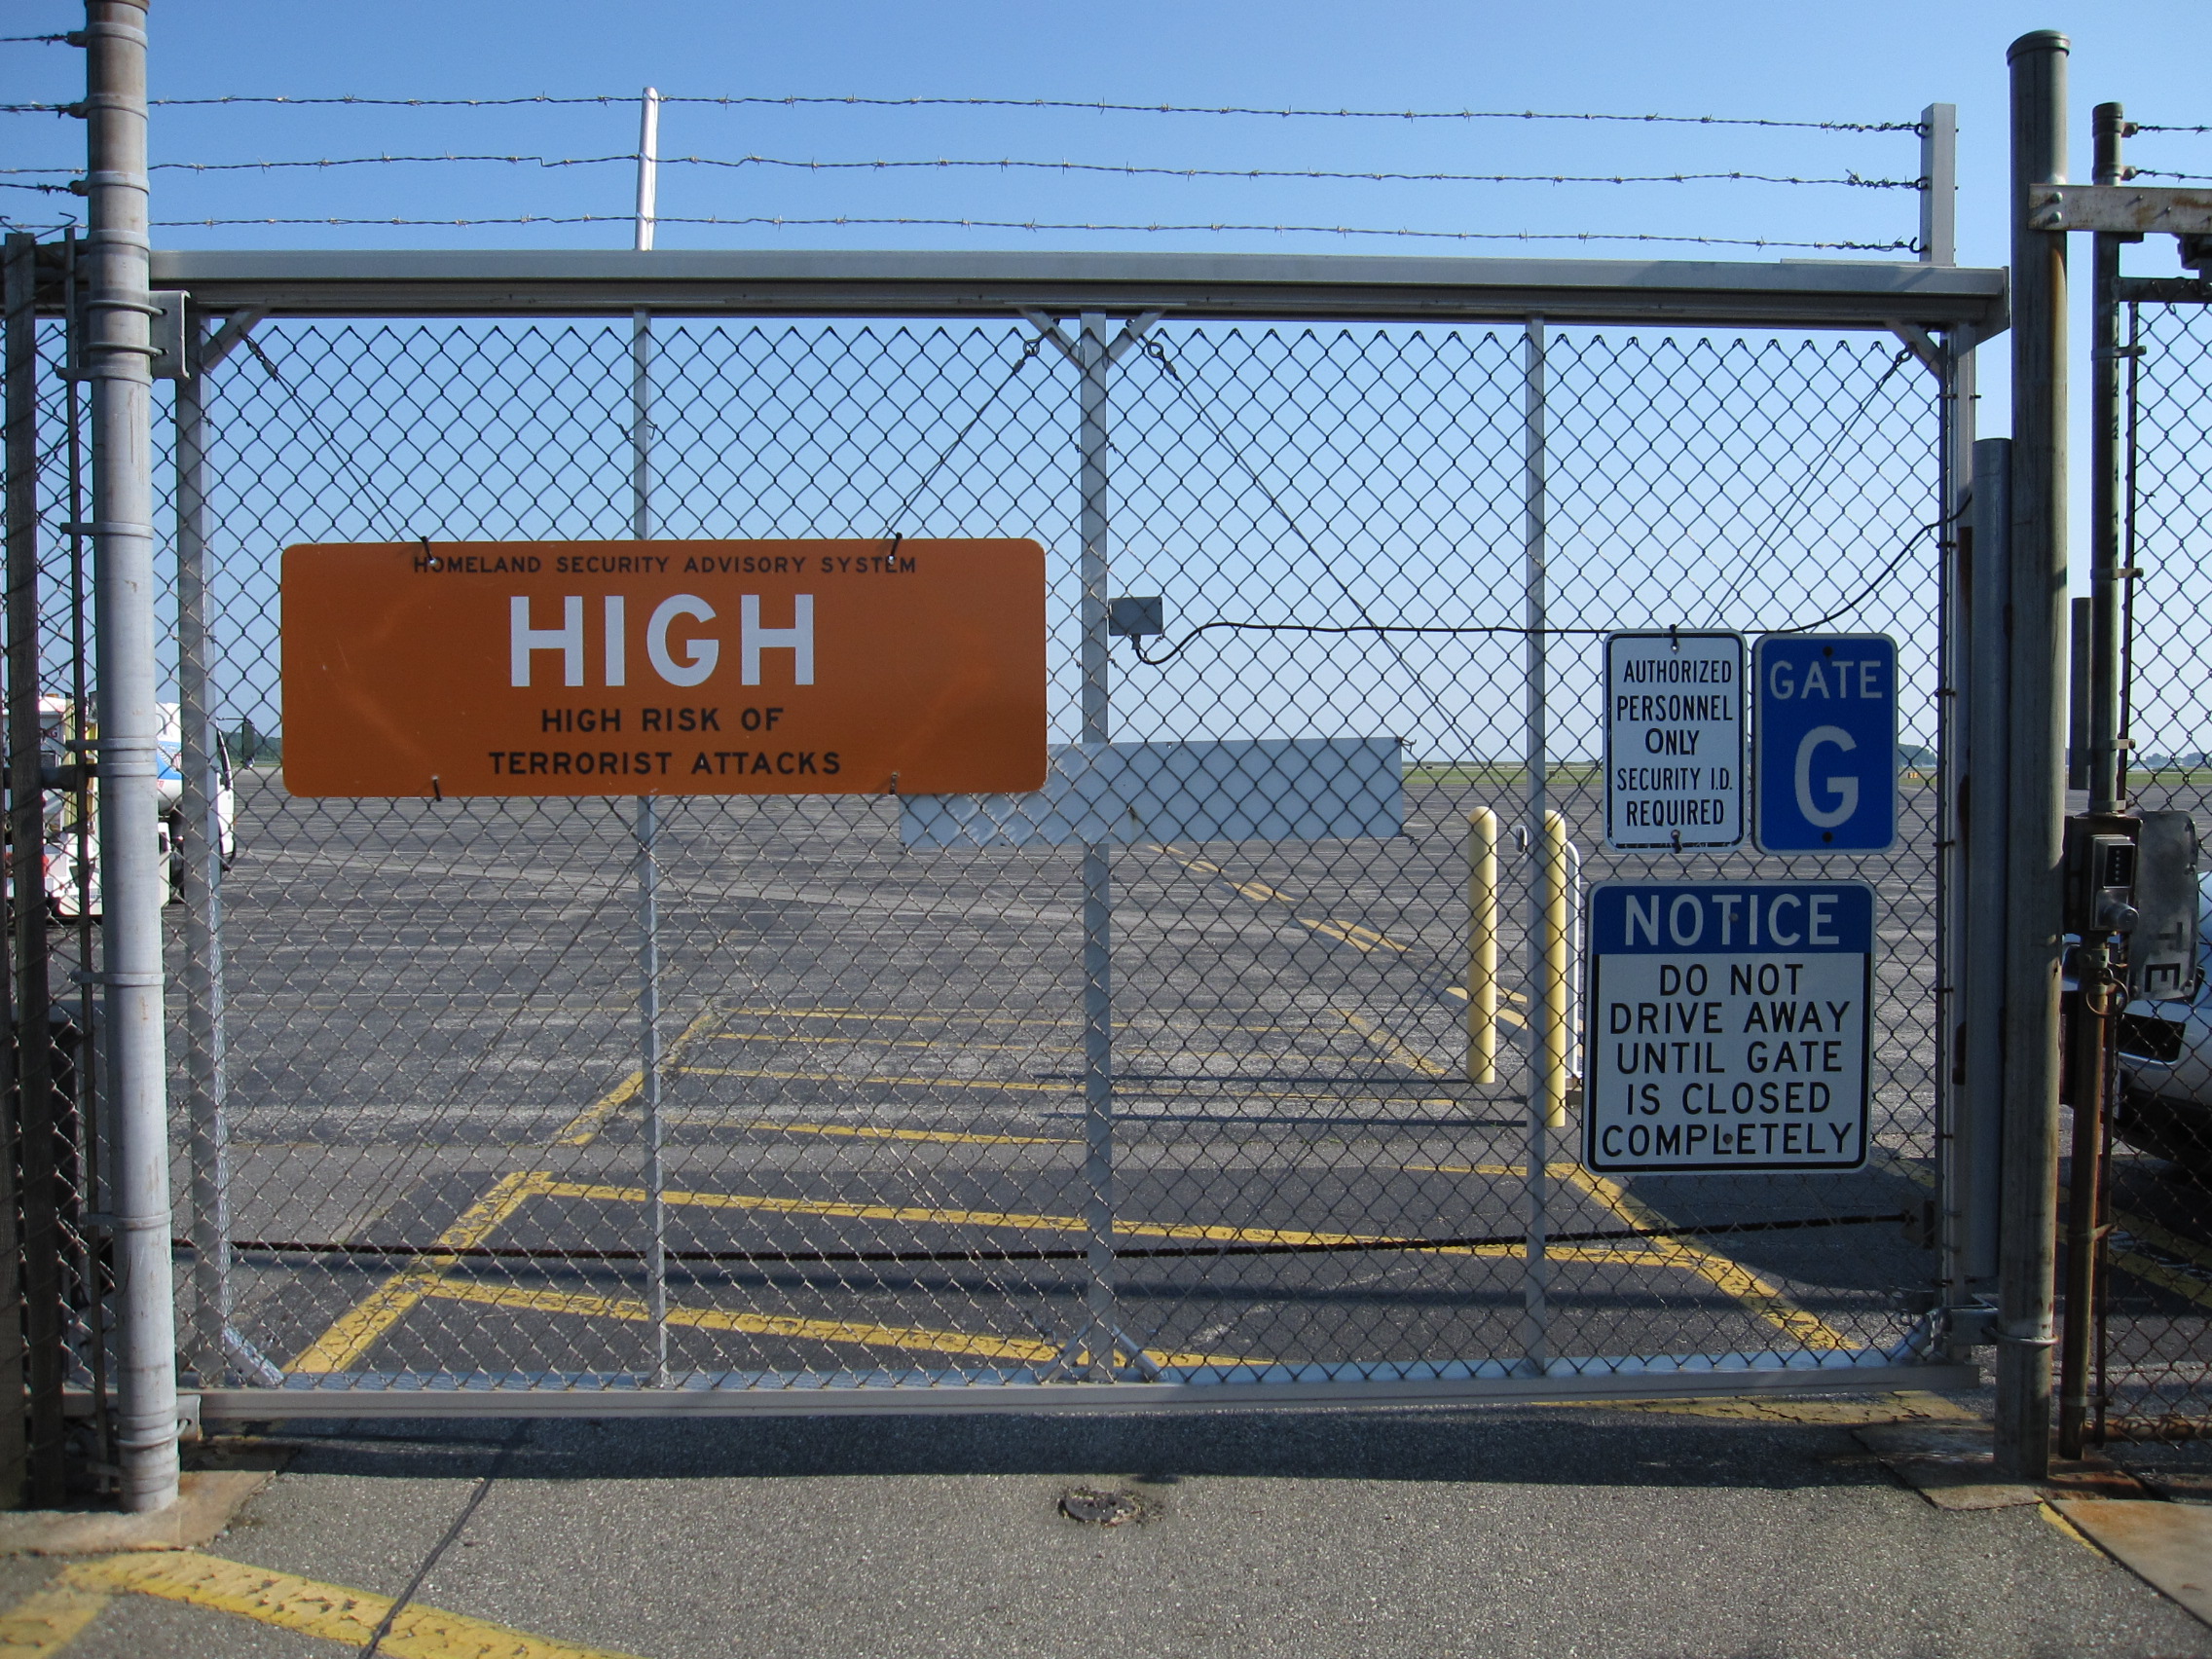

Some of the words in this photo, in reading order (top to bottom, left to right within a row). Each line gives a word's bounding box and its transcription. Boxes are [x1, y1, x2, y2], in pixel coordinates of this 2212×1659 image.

[414, 556, 541, 573] HOMELAND
[556, 556, 670, 573] SECURITY
[683, 556, 807, 573] ADVISORY
[821, 556, 916, 573] SYSTEM
[510, 594, 814, 687] HIGH
[1623, 659, 1733, 683] AUTHORIZED
[1769, 660, 1883, 700] GATE
[541, 708, 622, 732] HIGH
[642, 707, 721, 732] RISK
[740, 707, 784, 731] OF
[1616, 694, 1733, 721] PERSONNEL
[1644, 727, 1700, 756] ONLY
[489, 751, 673, 775] TERRORIST
[690, 751, 841, 775] ATTACKS
[1616, 767, 1701, 792] SECURITY
[1711, 767, 1733, 792] I.D.
[1794, 724, 1860, 829] G
[1626, 798, 1725, 827] REQUIRED
[1624, 893, 1840, 946] NOTICE
[1659, 963, 1709, 997] DO
[1730, 963, 1804, 996] NOT
[1609, 1002, 1723, 1035] DRIVE
[1743, 1000, 1851, 1034] AWAY
[1616, 1042, 1725, 1075] UNTIL
[1747, 1040, 1842, 1073] GATE
[1627, 1083, 1661, 1116] IS
[1681, 1082, 1830, 1115] CLOSED
[1602, 1122, 1853, 1158] COMPLETELY
